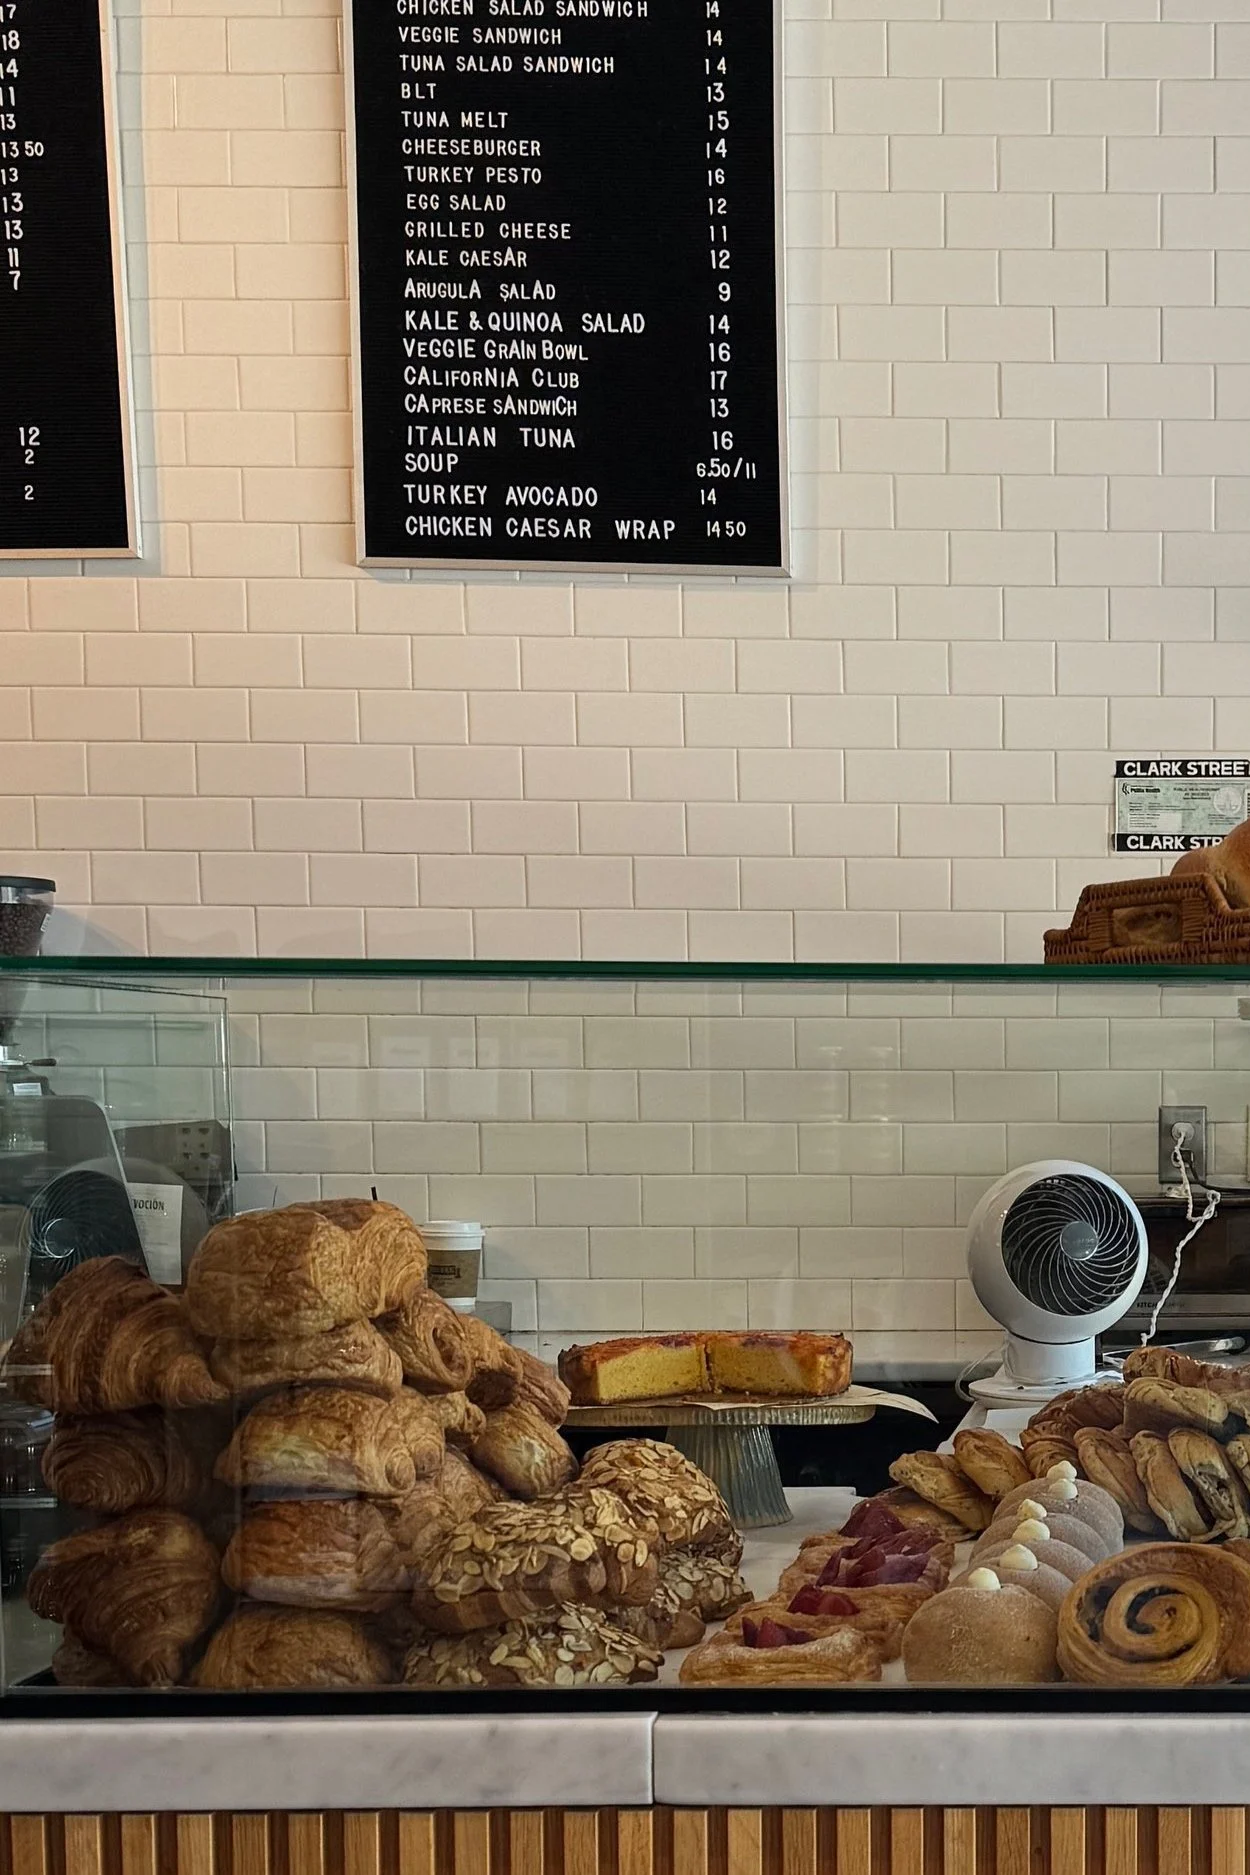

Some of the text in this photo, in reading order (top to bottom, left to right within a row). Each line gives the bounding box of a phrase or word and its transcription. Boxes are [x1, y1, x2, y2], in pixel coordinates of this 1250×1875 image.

[396, 0, 720, 19] CHICKEN SALAD SANDWICH 14
[1, 29, 21, 52] 18
[398, 25, 723, 47] VEGGIE SANDWICH 14
[399, 53, 727, 75] TUNA SALAD SANDWICH 14
[401, 82, 725, 103] BLT 13
[400, 110, 730, 132] TUNA MELT 15
[401, 137, 728, 159] CHEESEBURGER 14
[0, 167, 19, 186] 13
[403, 165, 725, 187] TURKEY PESTO 16
[2, 192, 24, 214] 13
[406, 193, 727, 216] EGG SALAD 12
[4, 219, 24, 240] 13
[404, 220, 727, 242] GRILLED CHEESE 11
[7, 247, 19, 268] 11
[405, 246, 731, 270] KALE CAESAR 12
[8, 270, 21, 291] 7
[404, 277, 731, 303] ARUGULA SALAD 9
[405, 309, 731, 335] KALE & QUINOA SALAD 14
[402, 337, 731, 363] VEGGIE GRAIN BOWL 16
[403, 365, 728, 391] CALIFORNIA CLUB 17
[404, 393, 730, 418] CAPRESE SANDWICH 13
[18, 426, 41, 447] 12
[407, 425, 734, 451] ITALIAN TUNA 16
[24, 448, 35, 465] 2
[404, 452, 459, 473] SOUP
[24, 484, 35, 501] 2
[402, 483, 717, 507] TURKEY AVOCADO 14
[405, 515, 492, 537] CHICKEN
[505, 517, 592, 539] CAESAR
[614, 519, 676, 540] WRAP
[1123, 761, 1183, 776] CLARK
[1126, 835, 1224, 850] CLARK STR
